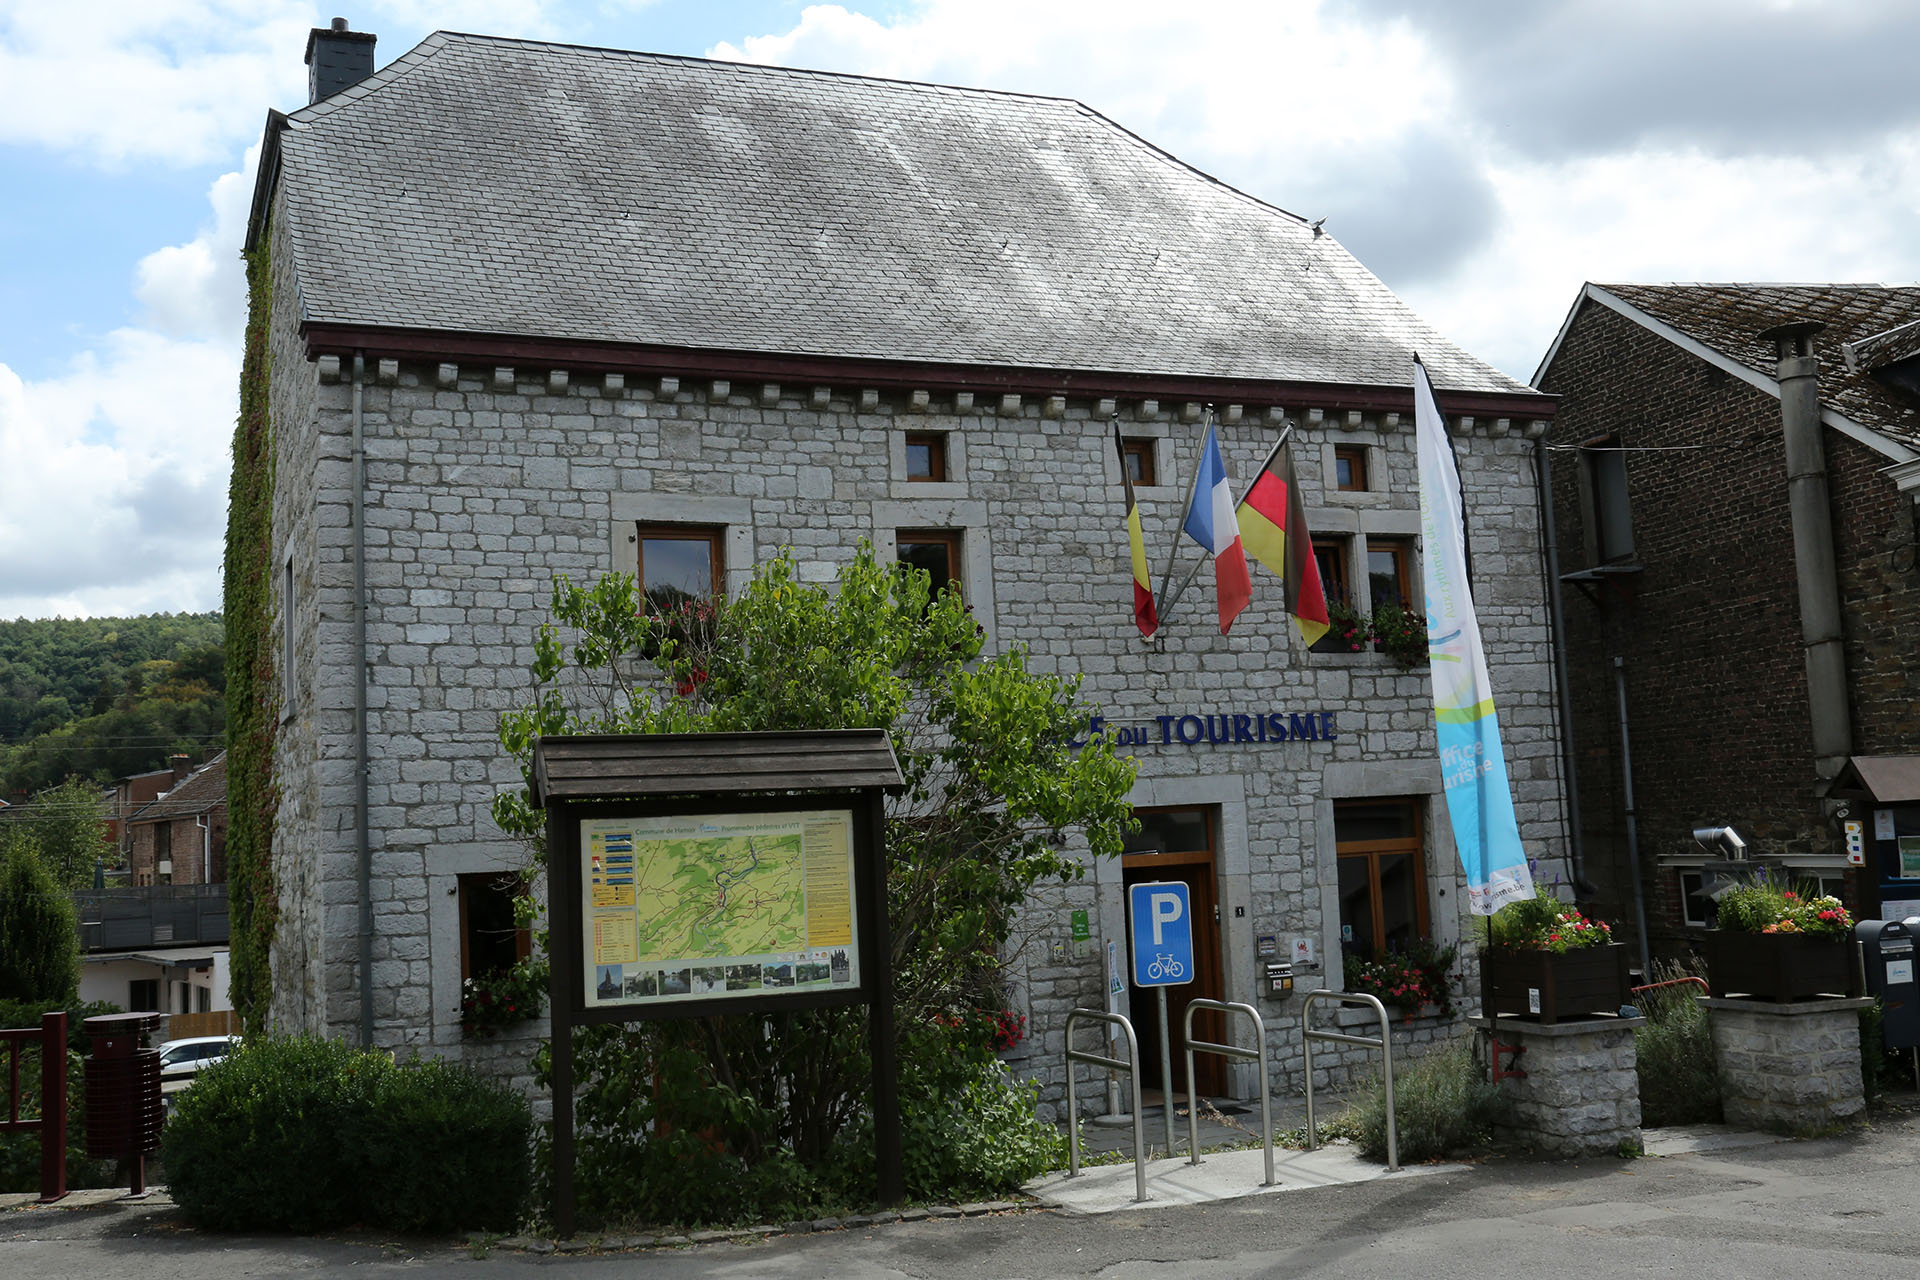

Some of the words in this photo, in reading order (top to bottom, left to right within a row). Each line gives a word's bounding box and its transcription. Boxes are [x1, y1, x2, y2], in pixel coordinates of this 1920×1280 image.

[1117, 726, 1148, 747] DU
[1156, 711, 1338, 746] TOURISME
[1151, 892, 1183, 945] P
